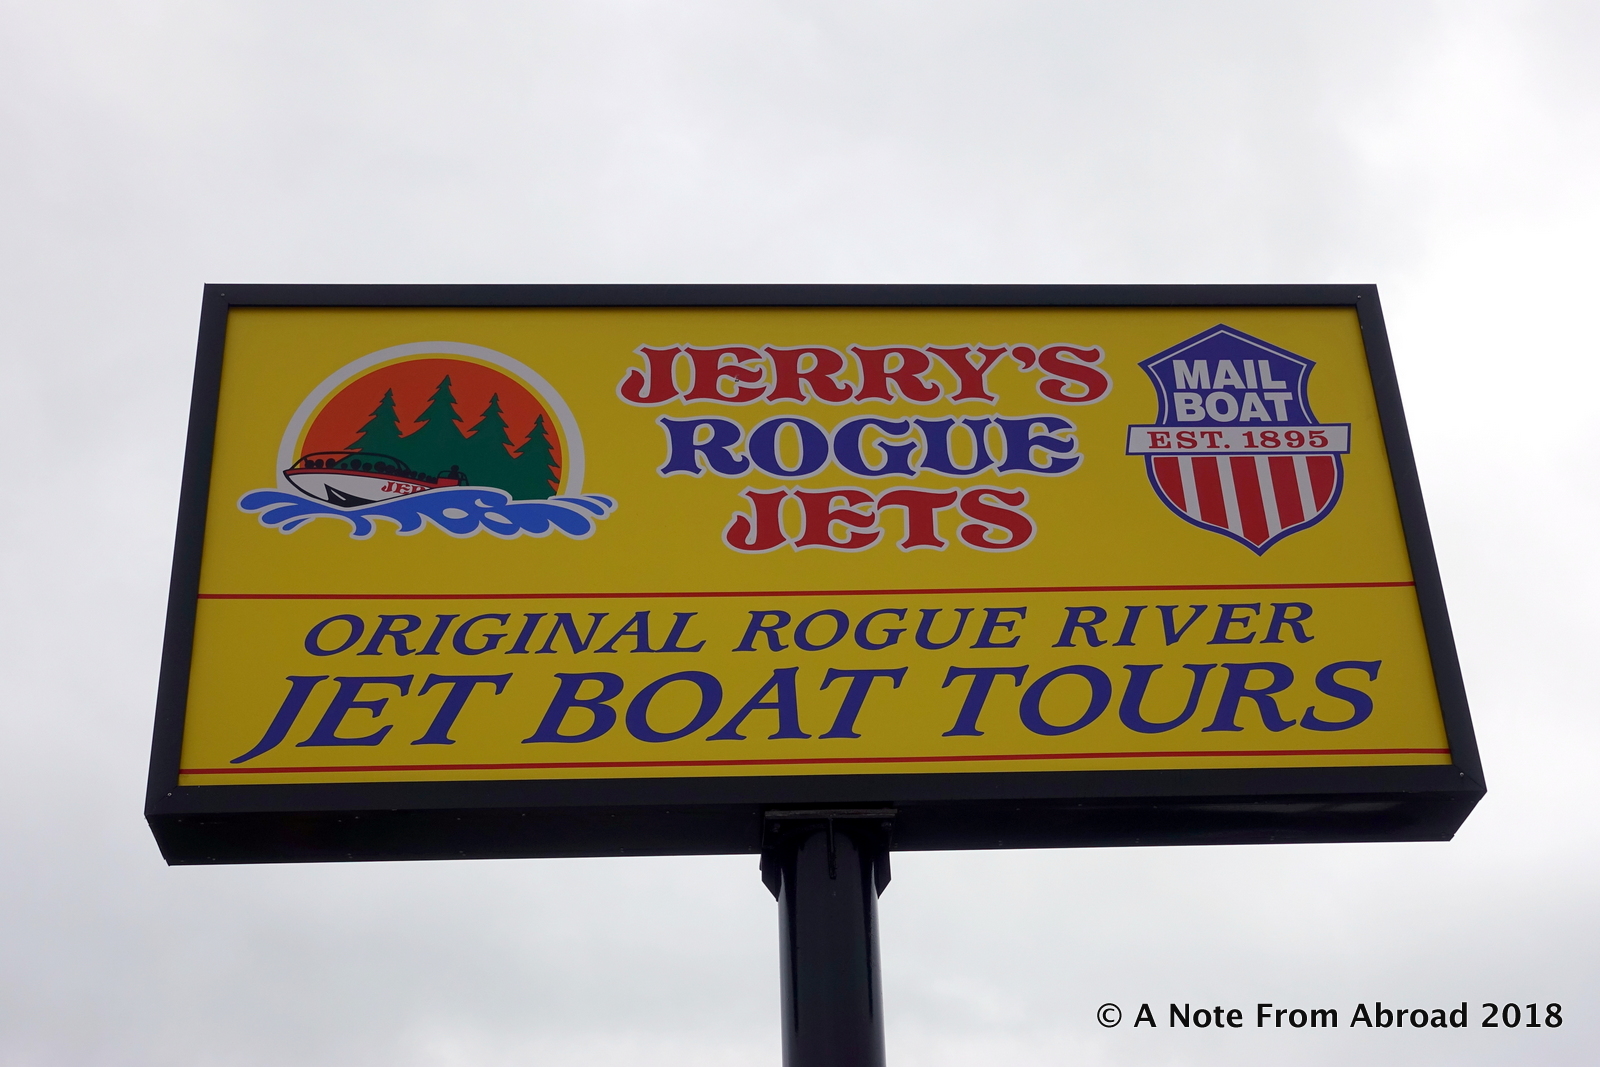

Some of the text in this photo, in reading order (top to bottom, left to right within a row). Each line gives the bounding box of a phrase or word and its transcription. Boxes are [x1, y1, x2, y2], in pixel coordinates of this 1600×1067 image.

[620, 345, 1109, 405] JERRY'S
[1172, 359, 1288, 390] MAIL
[1173, 391, 1294, 423] BOAT
[658, 416, 1081, 477] ROGUE
[1146, 429, 1329, 449] EST. 1895
[725, 487, 1034, 552] JETS
[304, 602, 1315, 656] ORIGINAL ROGUE RIVER
[230, 660, 1382, 764] JET BOAT TOURS
